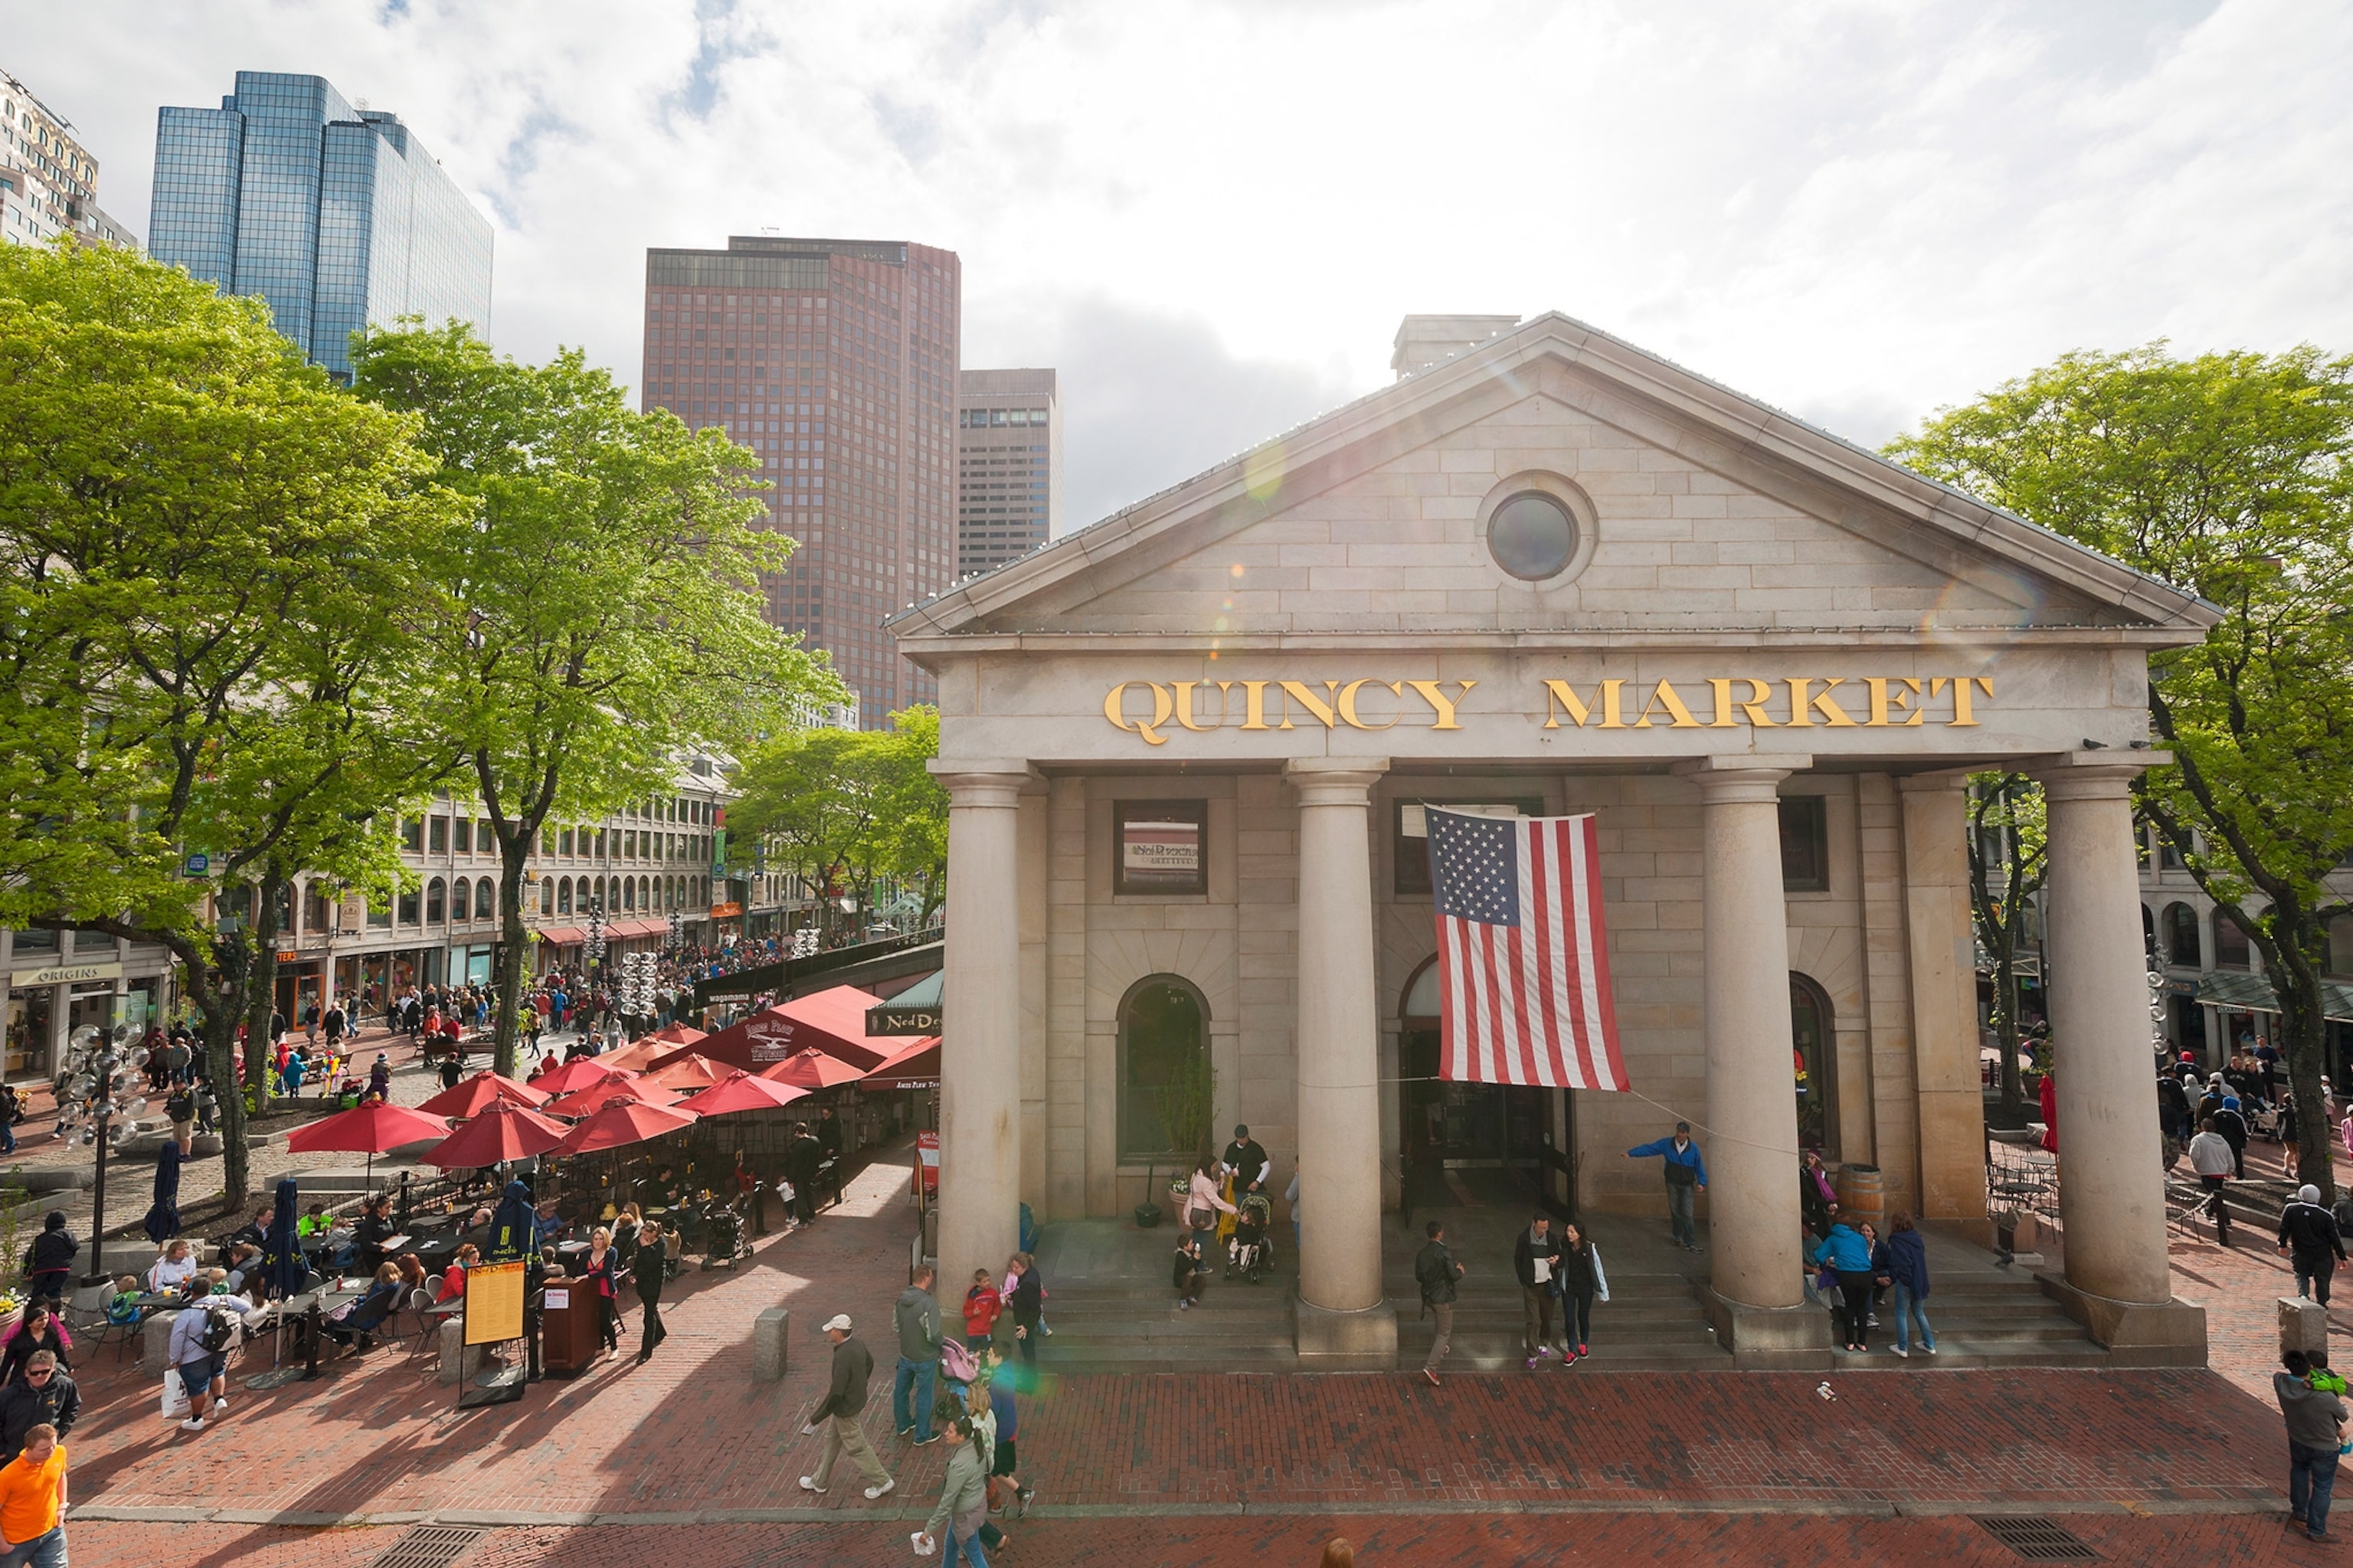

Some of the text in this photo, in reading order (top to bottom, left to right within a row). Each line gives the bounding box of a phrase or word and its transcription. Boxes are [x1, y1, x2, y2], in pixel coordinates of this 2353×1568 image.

[1104, 677, 1993, 745] QUINCY MARKET
[39, 968, 98, 982] ORIGINS
[709, 994, 750, 1003] wagamama
[886, 1014, 915, 1031] Ned
